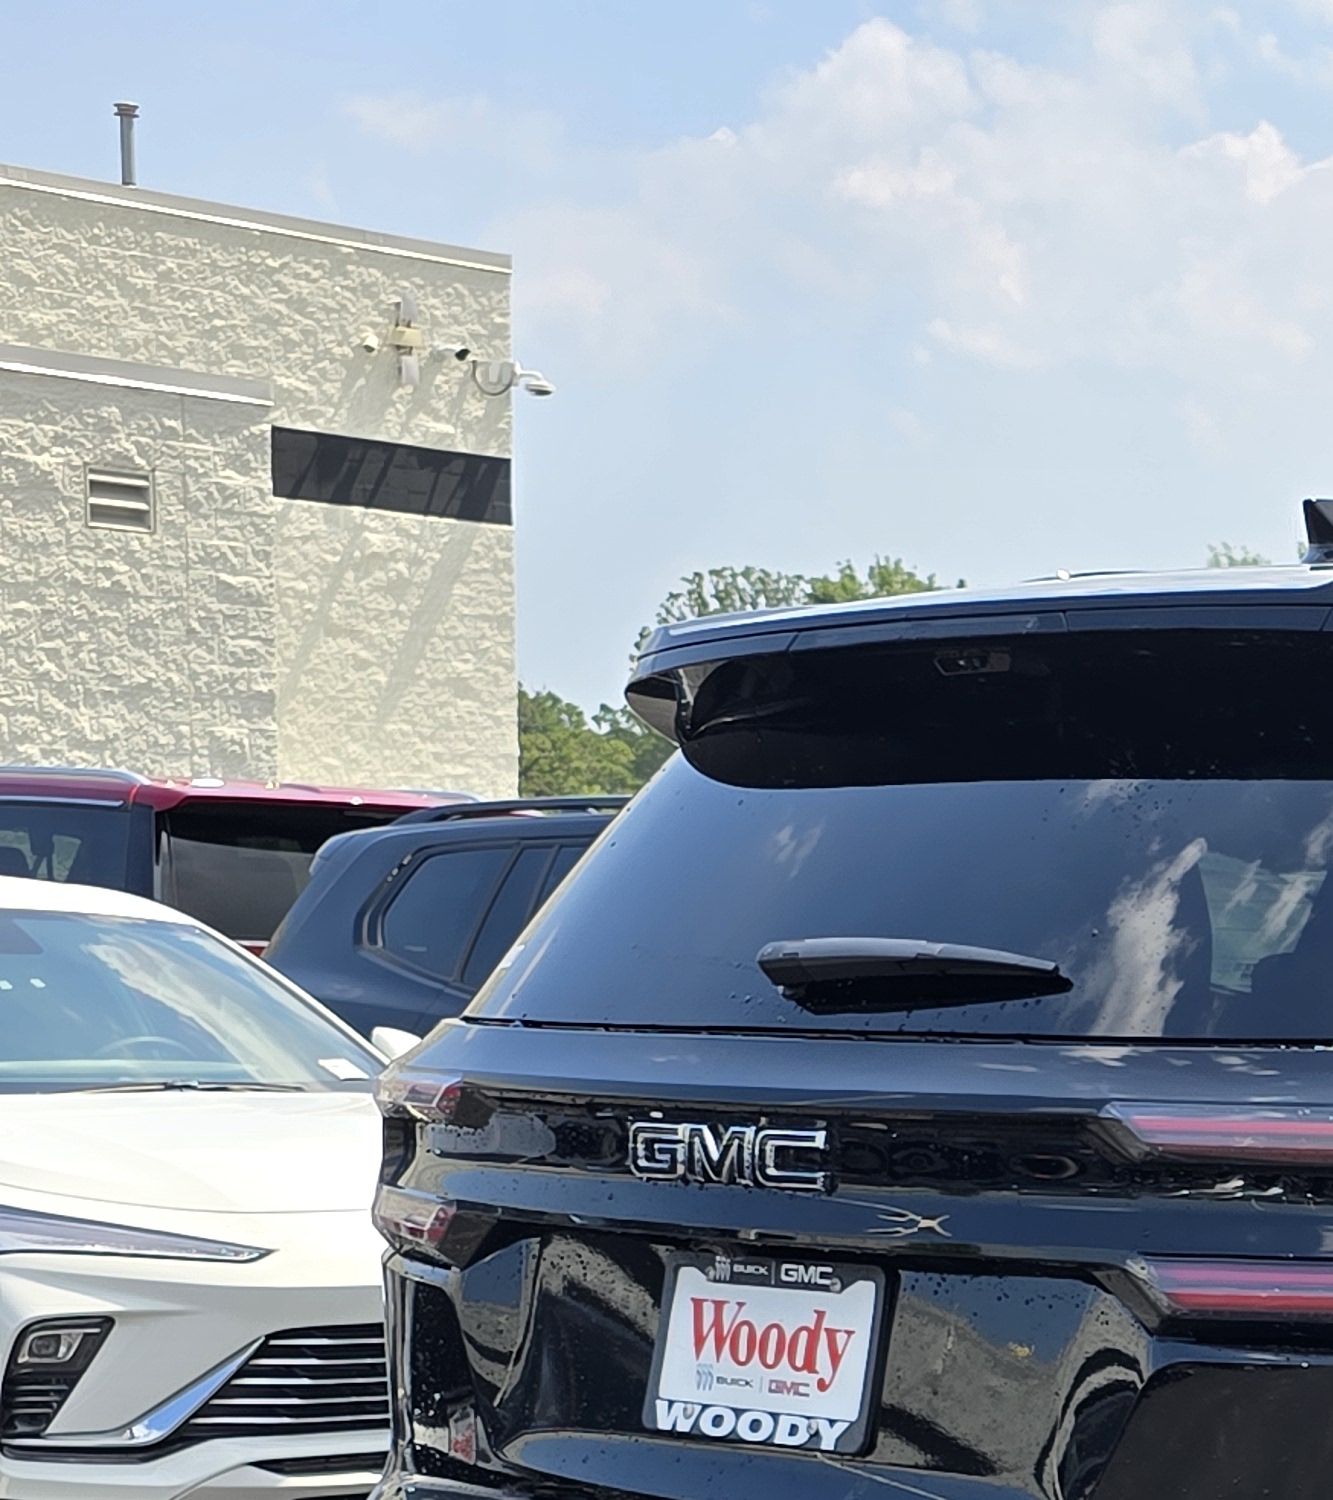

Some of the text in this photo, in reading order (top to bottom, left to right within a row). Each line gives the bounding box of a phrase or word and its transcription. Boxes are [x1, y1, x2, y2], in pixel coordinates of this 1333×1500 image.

[629, 1121, 829, 1191] GMC
[733, 1263, 833, 1285] BUICK GMC
[691, 1297, 855, 1392] Woody
[716, 1376, 810, 1397] BUICK GMC
[655, 1399, 852, 1450] WOODY
